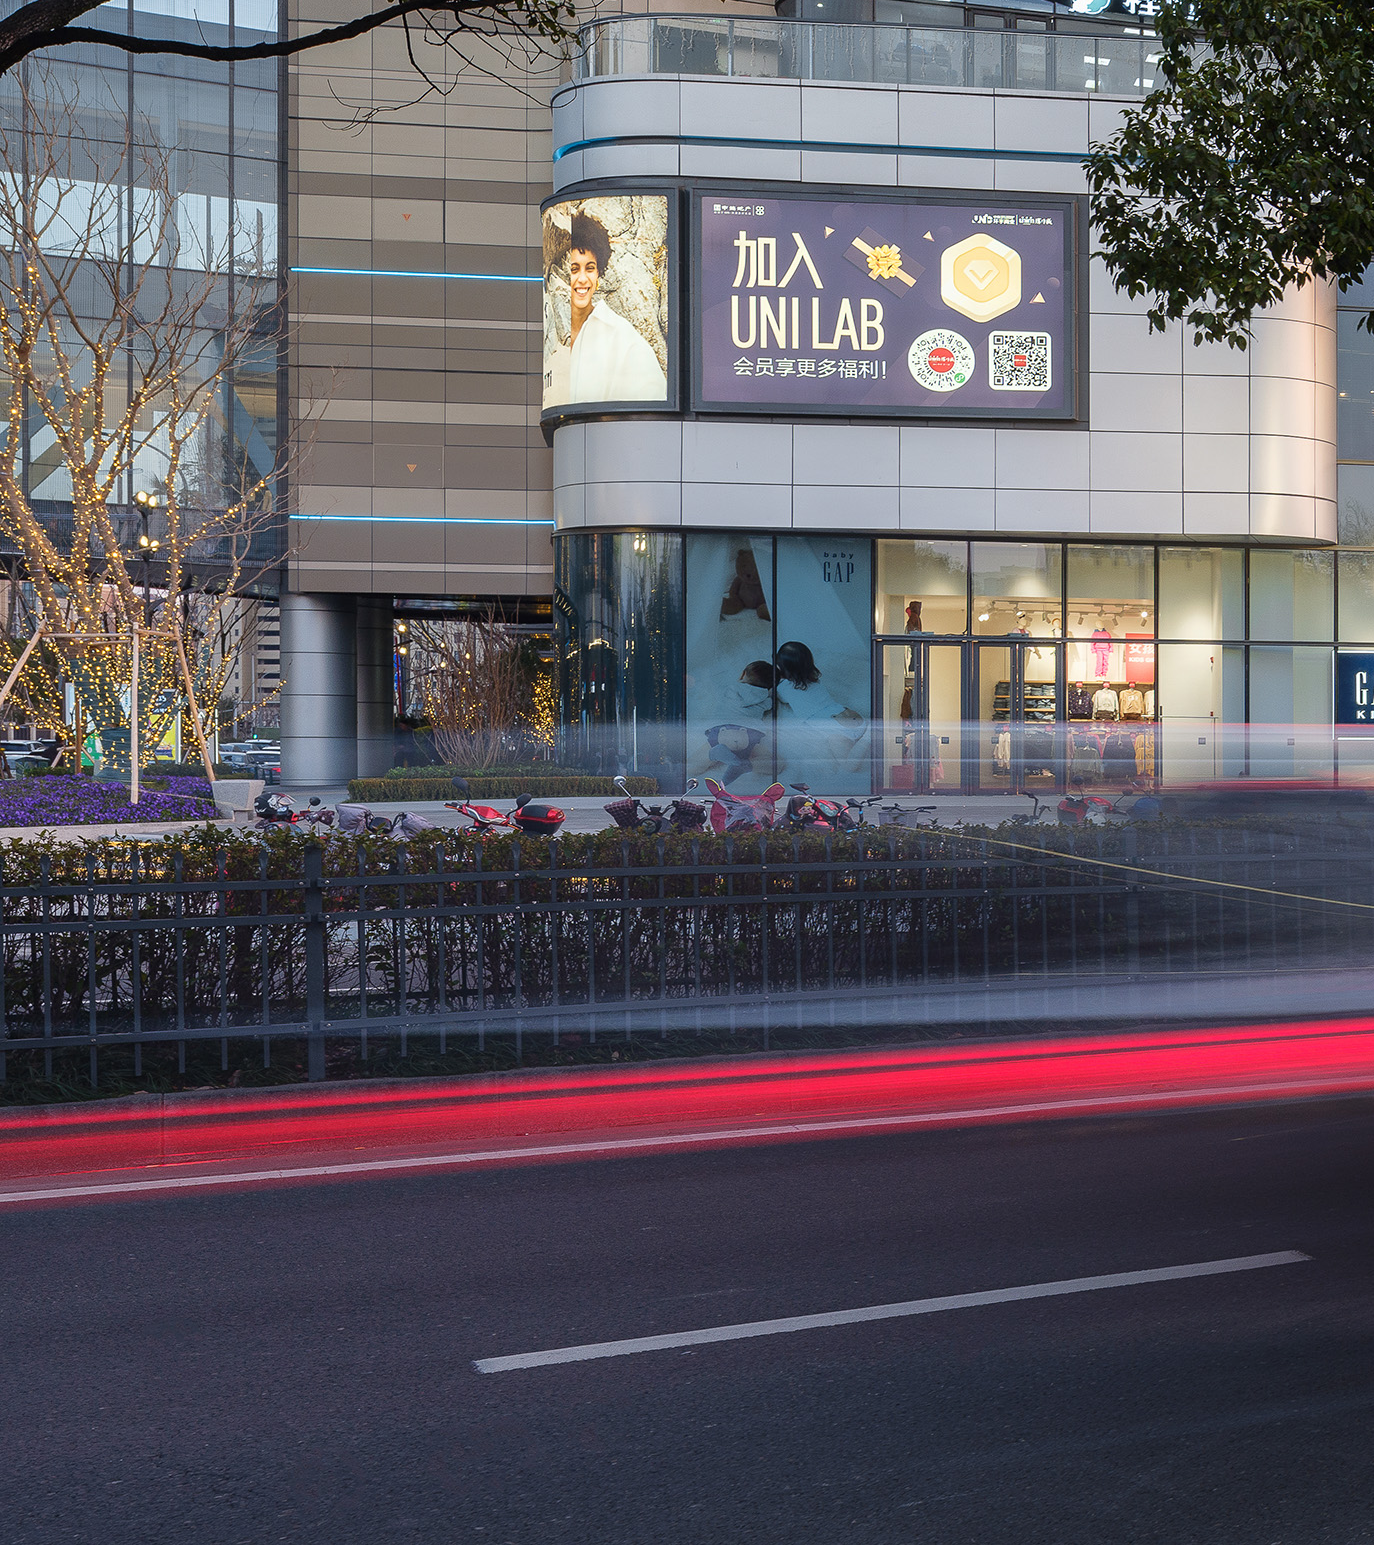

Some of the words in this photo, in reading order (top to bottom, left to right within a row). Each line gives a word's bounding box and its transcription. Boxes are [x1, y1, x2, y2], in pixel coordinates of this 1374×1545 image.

[731, 230, 824, 289] 加入
[731, 295, 799, 349] UNI
[812, 297, 885, 351] LAB
[823, 551, 854, 560] baby
[823, 561, 854, 583] GAP
